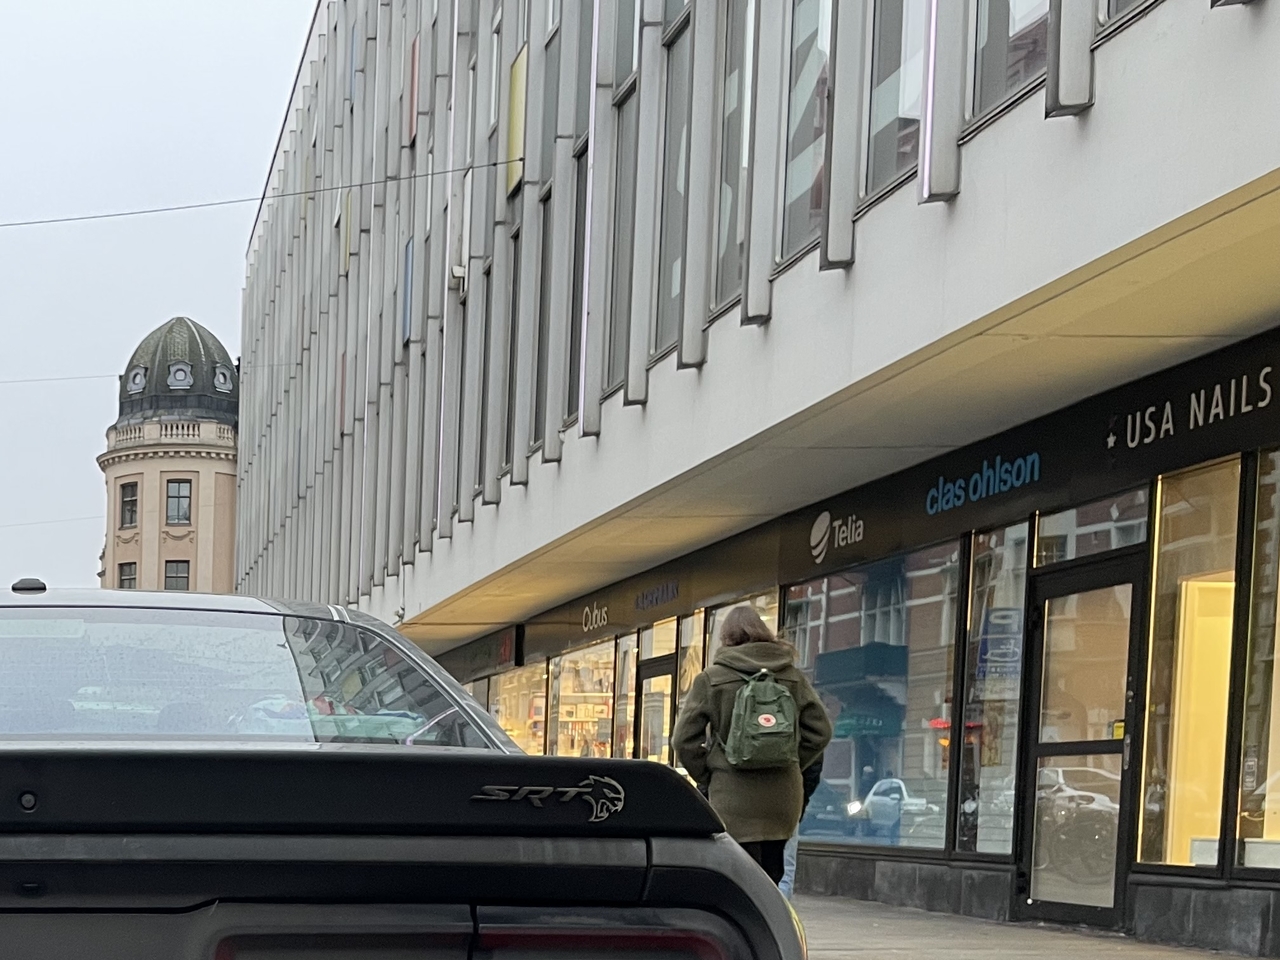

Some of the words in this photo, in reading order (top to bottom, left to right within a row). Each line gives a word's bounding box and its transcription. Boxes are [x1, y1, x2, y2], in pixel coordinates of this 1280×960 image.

[1127, 401, 1174, 448] USA
[1189, 366, 1272, 430] NAILS
[926, 476, 966, 515] clas
[969, 452, 1040, 501] ohlson
[832, 514, 864, 548] Telia
[470, 785, 592, 807] SRT
